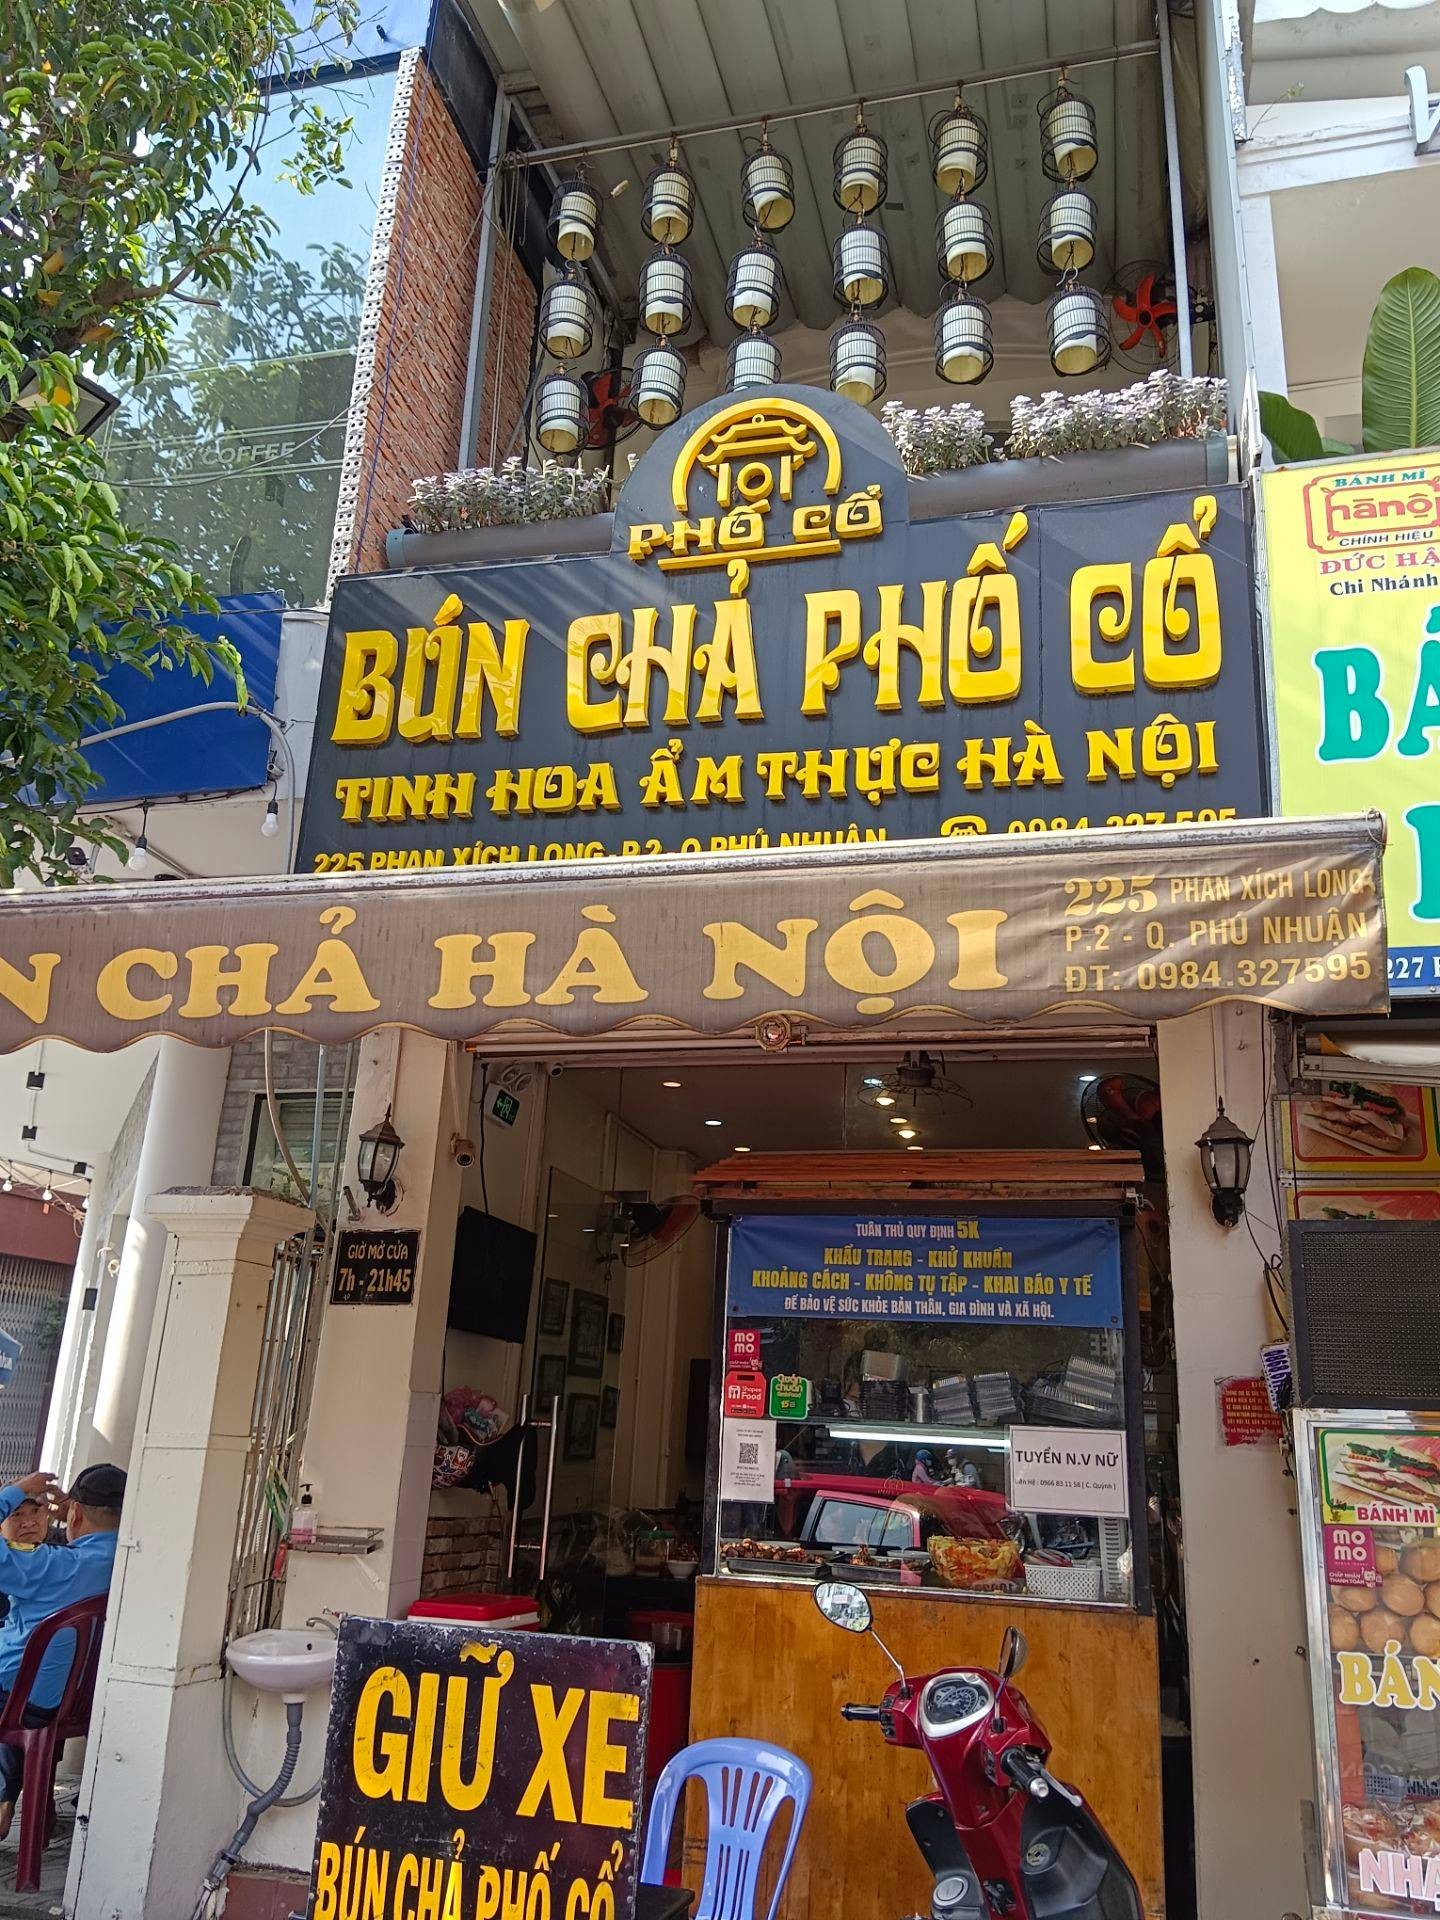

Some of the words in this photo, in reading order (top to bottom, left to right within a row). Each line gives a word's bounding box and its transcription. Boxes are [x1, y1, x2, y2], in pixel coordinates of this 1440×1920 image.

[628, 499, 771, 560] PHỐ
[792, 484, 883, 543] CỔ
[1320, 552, 1385, 574] ĐỨC
[1330, 579, 1364, 596] Chi
[1371, 573, 1439, 592] Nhánh
[331, 593, 530, 746] BÚN
[566, 559, 765, 734] CHẢ
[801, 511, 1028, 717] PHỐ
[1070, 495, 1223, 695] CỔ
[336, 771, 476, 823] TINH
[485, 762, 622, 815] HOA
[639, 738, 744, 807] ẨM
[757, 738, 940, 806] THỰC
[957, 719, 1064, 791] HÀ
[1086, 713, 1219, 788] NỘI
[314, 851, 364, 873] 225
[370, 849, 446, 870] PHAN
[453, 840, 521, 866] XÍCH
[528, 841, 605, 861] LONG
[711, 828, 770, 851] PHÚ
[1064, 874, 1158, 917] 225
[1170, 876, 1231, 903] PHAN
[1241, 868, 1293, 902] XÍCH
[1190, 911, 1248, 947] PHÚ
[1264, 907, 1368, 946] NHUẬN
[97, 906, 380, 1021] CHẢ
[428, 904, 649, 1009] HÀ
[702, 889, 1008, 1015] NỘI
[1137, 951, 1371, 991] 0984.327595
[856, 1221, 882, 1237] TUÂN
[907, 1224, 926, 1238] QUY
[956, 1219, 980, 1240] 5K
[348, 1240, 367, 1259] GIỜ
[368, 1240, 385, 1259] MỞ
[387, 1240, 409, 1259] CỬA
[866, 1248, 912, 1267] TRANG
[338, 1268, 355, 1291] 7h
[368, 1268, 411, 1292] 21h45
[752, 1266, 808, 1289] KHOẢNG
[812, 1269, 850, 1290] CÁCH
[865, 1270, 913, 1291] KHÔNG
[984, 1276, 1019, 1294] KHAI
[1024, 1272, 1054, 1295] BÁO
[1059, 1278, 1069, 1295] Y
[1073, 1274, 1093, 1296] TẾ
[949, 1301, 966, 1315] GIA
[998, 1300, 1012, 1317] VÀ
[741, 1392, 762, 1400] Food
[1015, 1446, 1061, 1464] TUYỂN
[1066, 1453, 1091, 1466] N.V
[1095, 1452, 1119, 1467] NỮ
[1357, 1504, 1408, 1523] BÁNH
[353, 1641, 515, 1812] GIỮ
[515, 1683, 640, 1830] XE
[313, 1826, 390, 1920] BÚN
[394, 1828, 466, 1920] CHẢ
[476, 1842, 562, 1920] PHỐ
